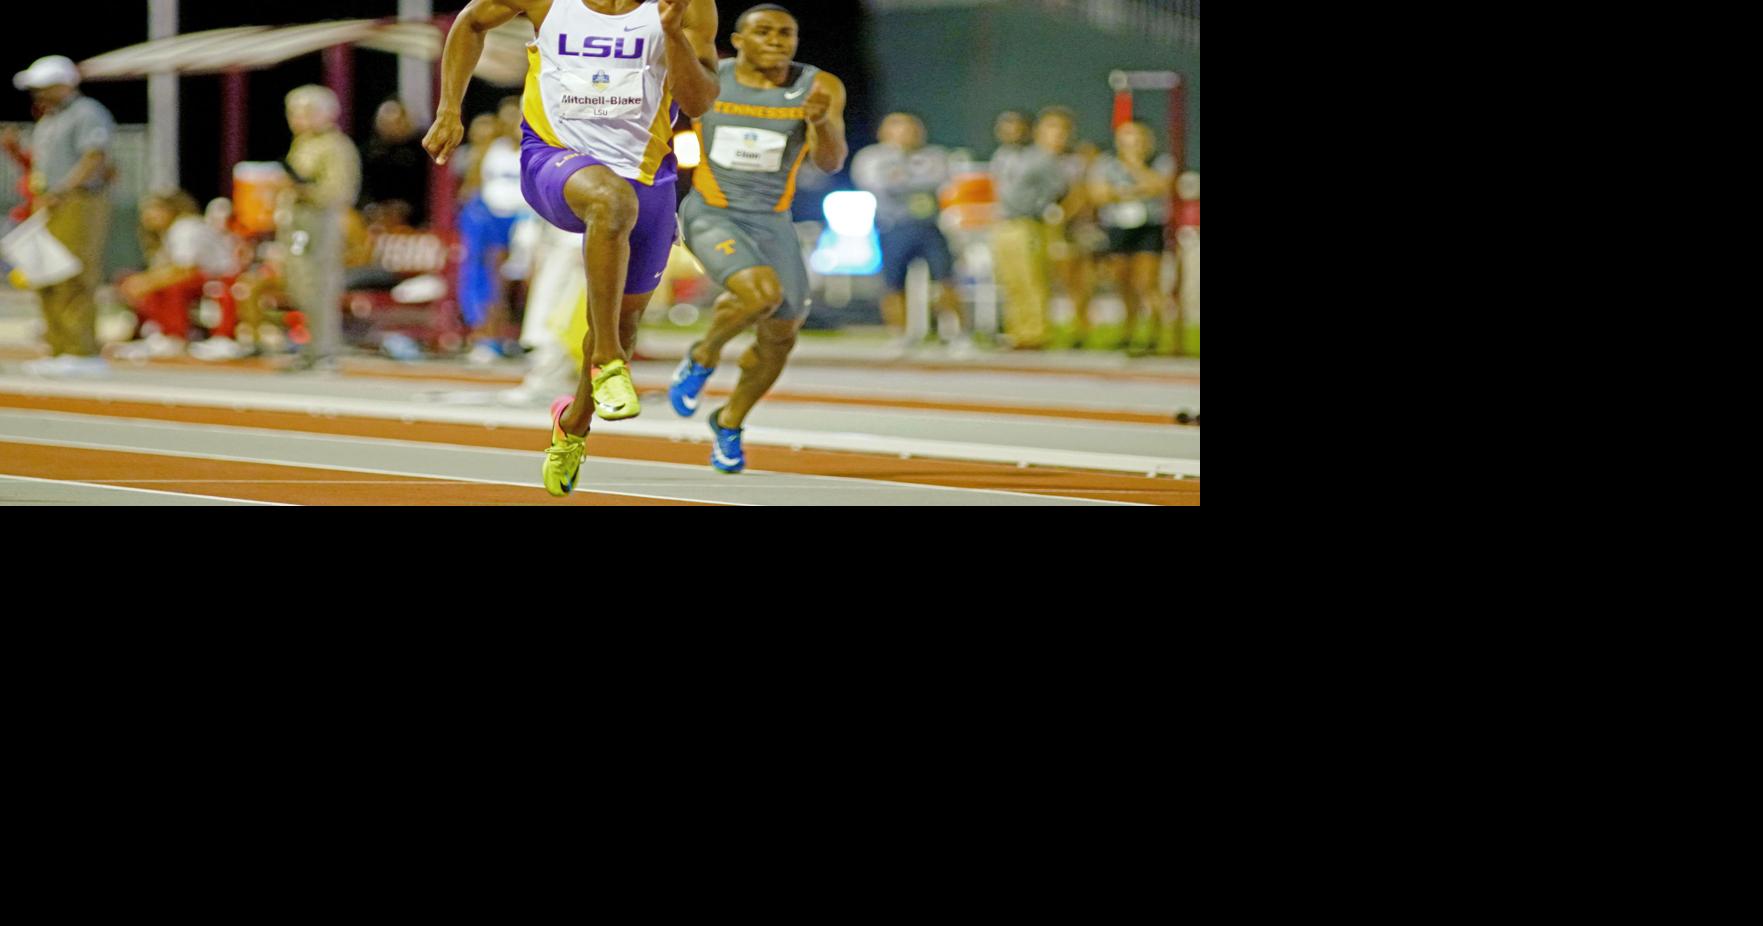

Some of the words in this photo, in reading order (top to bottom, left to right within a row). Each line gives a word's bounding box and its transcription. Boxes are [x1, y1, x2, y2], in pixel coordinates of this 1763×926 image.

[558, 33, 645, 59] LSU
[561, 95, 642, 105] Mitchell-Blake
[593, 108, 608, 116] LSU
